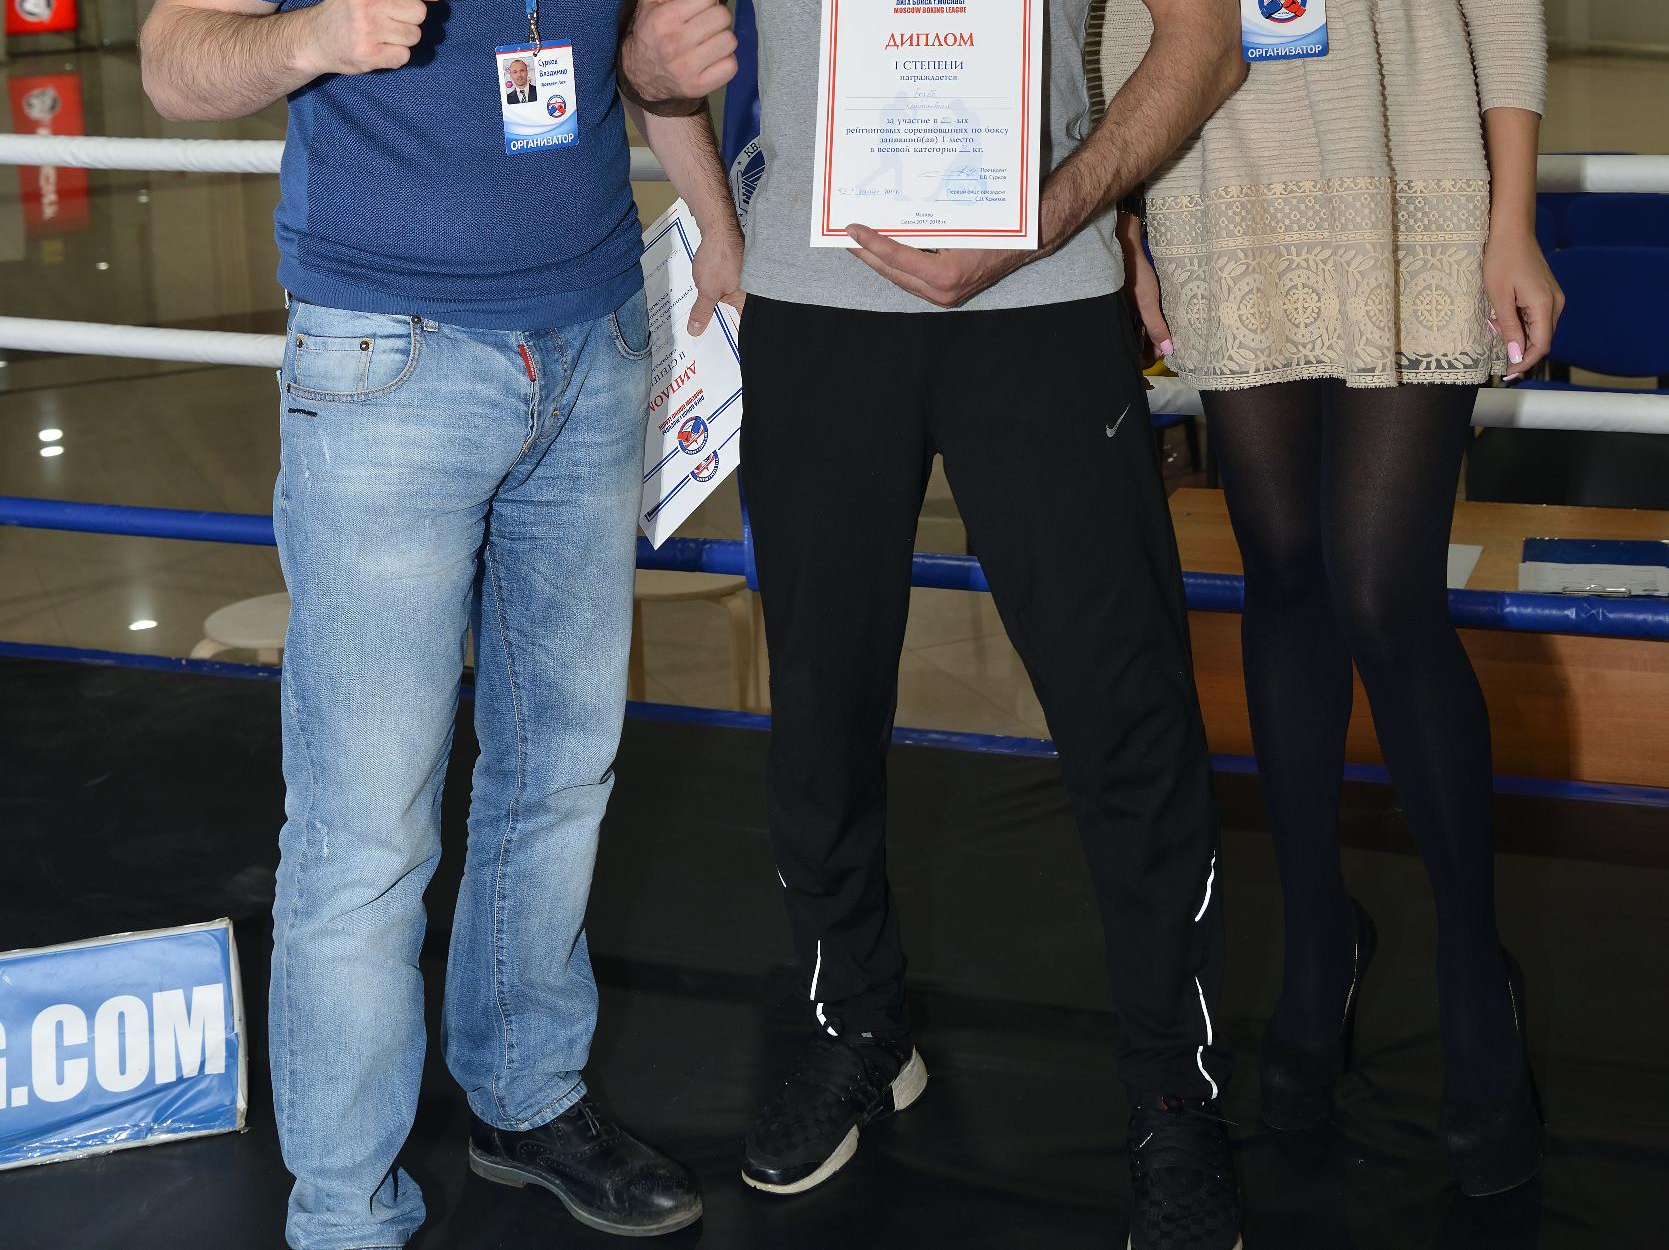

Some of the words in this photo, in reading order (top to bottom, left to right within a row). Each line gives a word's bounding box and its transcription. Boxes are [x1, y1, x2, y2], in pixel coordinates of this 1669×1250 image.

[945, 6, 967, 14] LEAGUE
[885, 32, 975, 50] ДИПЛОМ
[1247, 44, 1323, 58] ОРГАНИЗАТОР
[902, 60, 964, 70] СТЕПЕНИ
[899, 74, 958, 83] награждается
[897, 117, 931, 125] участие
[844, 126, 901, 136] рейтинговых
[903, 128, 969, 136] соревнованиях
[984, 126, 1009, 136] боксу
[510, 133, 575, 151] ОРГАНИЗАТОР
[0, 982, 227, 1110] .COM
